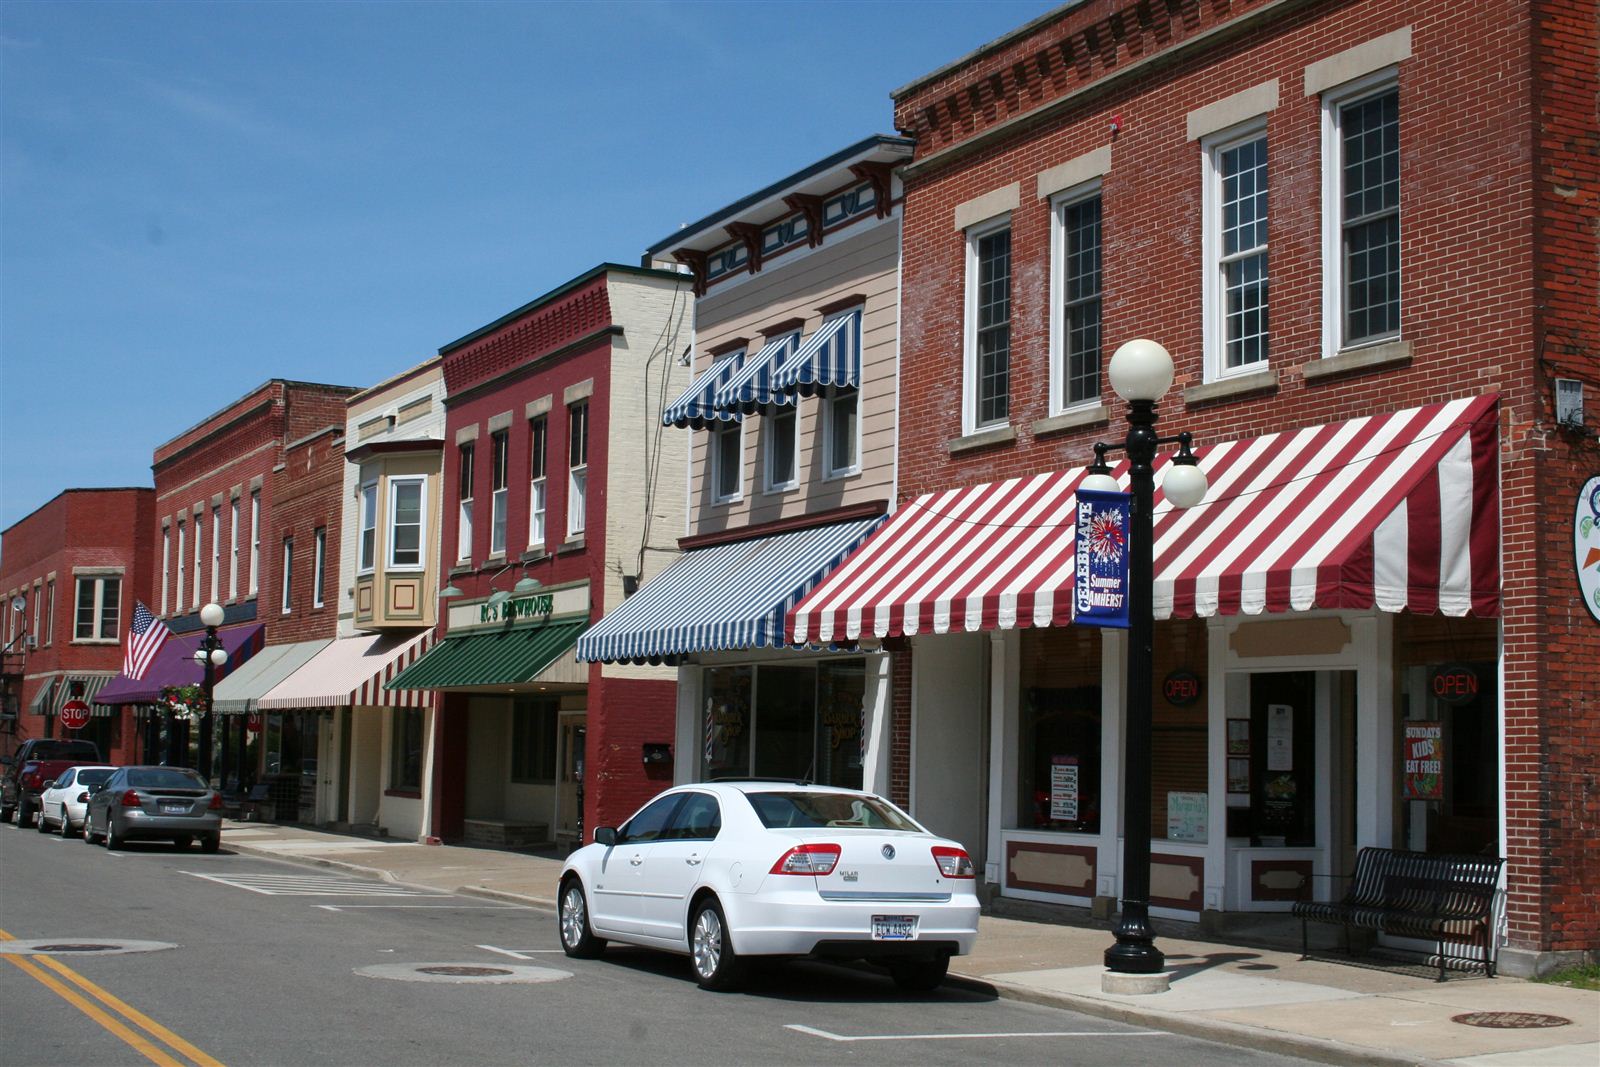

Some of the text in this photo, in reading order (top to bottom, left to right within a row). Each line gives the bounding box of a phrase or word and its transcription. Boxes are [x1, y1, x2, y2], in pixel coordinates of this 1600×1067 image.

[1077, 502, 1092, 612] CELEBRATE
[1090, 573, 1121, 589] Summer
[1088, 590, 1124, 608] AMHERST
[1164, 679, 1197, 697] OPEN
[1433, 674, 1477, 695] OPEN
[63, 708, 88, 719] STOP
[1405, 726, 1440, 738] SUNDAYS
[1411, 738, 1435, 759] KIDS
[1406, 760, 1441, 773] EAT FREE!
